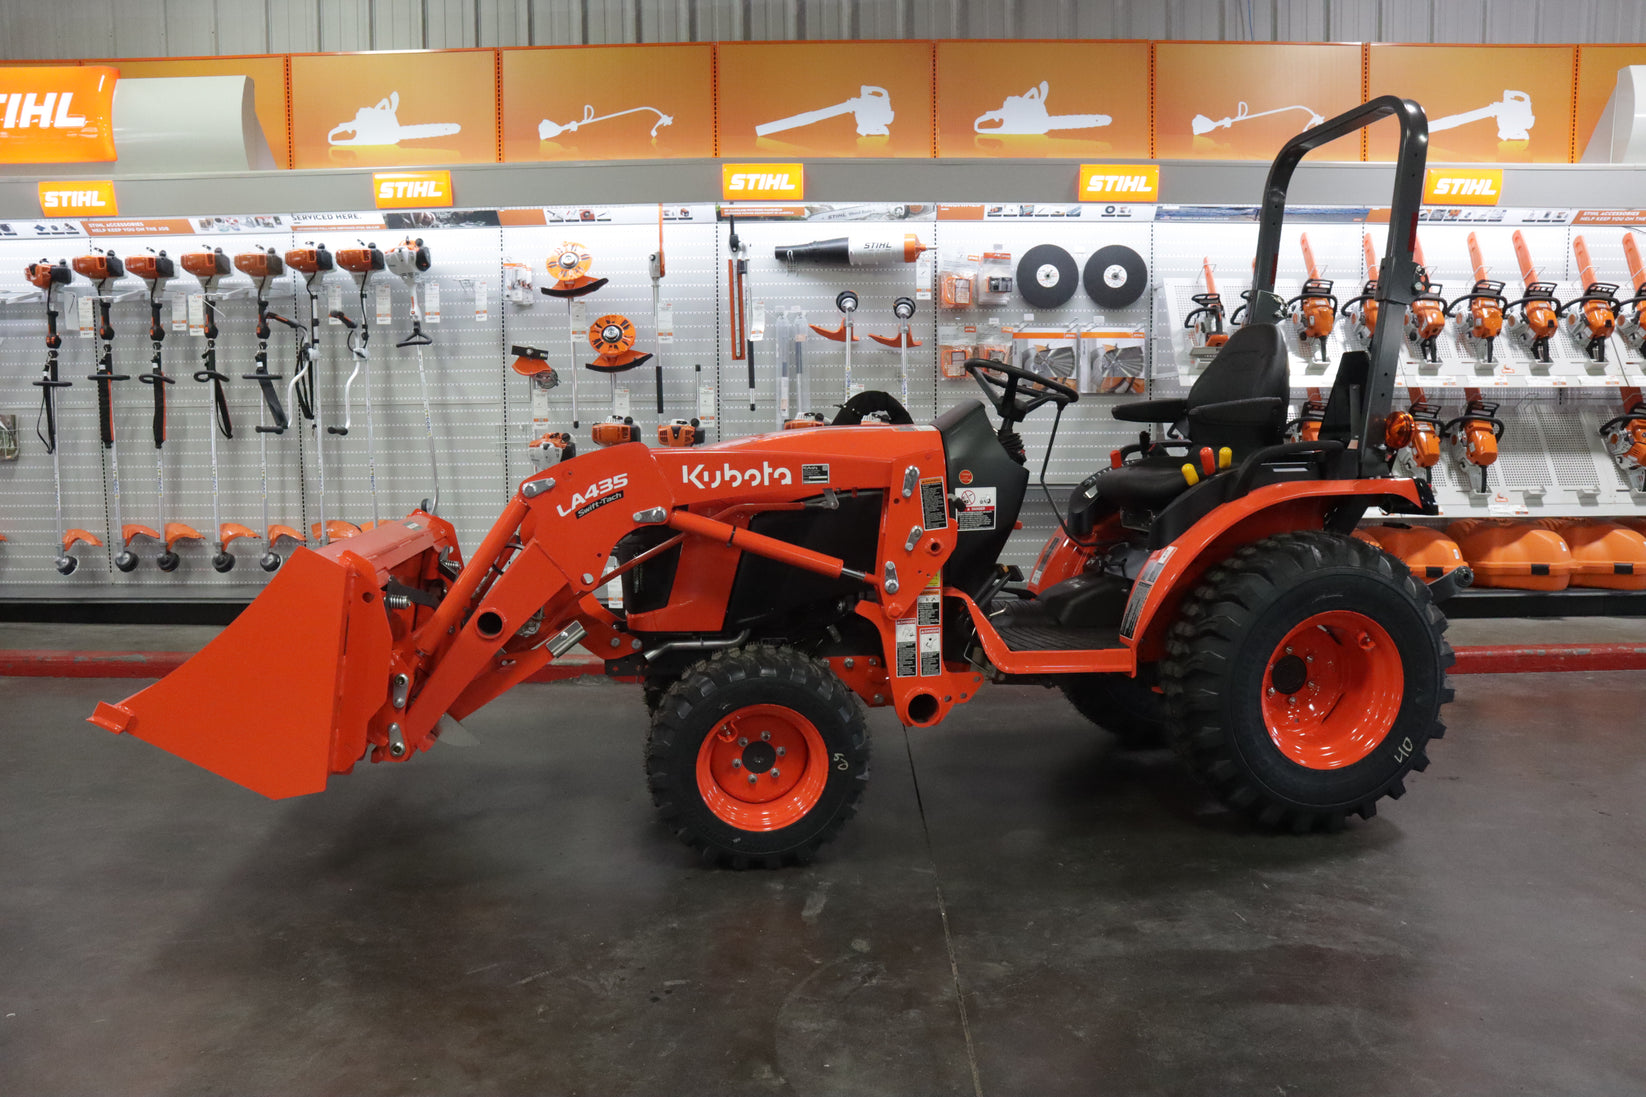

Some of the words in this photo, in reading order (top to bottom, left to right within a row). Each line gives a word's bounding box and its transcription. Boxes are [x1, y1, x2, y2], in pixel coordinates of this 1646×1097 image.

[379, 181, 442, 198] STIHL
[729, 174, 795, 190] STIHL
[1087, 175, 1152, 191] STIHL
[1432, 178, 1496, 195] STIHL
[44, 191, 105, 207] STIHL
[291, 213, 333, 221] SERVICED
[336, 212, 362, 220] HERE.
[864, 241, 891, 249] STIHL
[682, 461, 792, 489] Kubota
[556, 473, 628, 517] LA435
[577, 493, 622, 517] Swift-Tach
